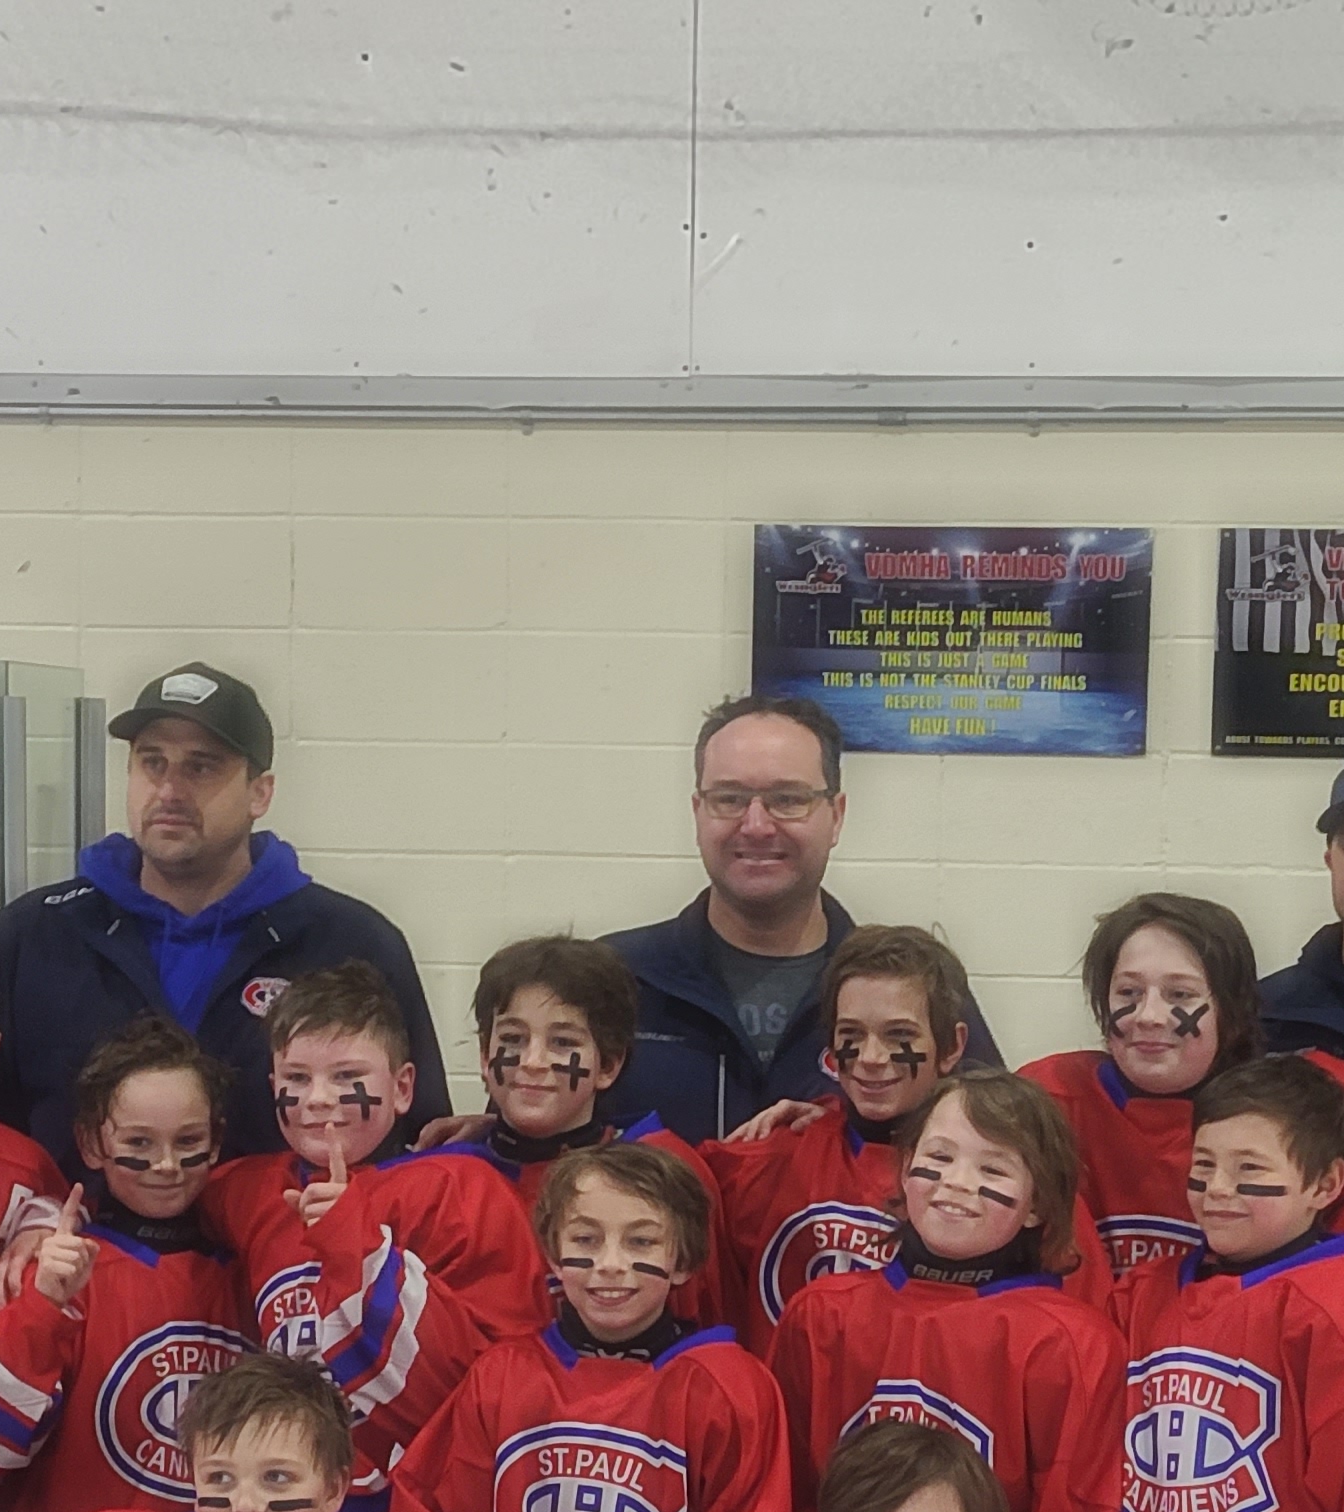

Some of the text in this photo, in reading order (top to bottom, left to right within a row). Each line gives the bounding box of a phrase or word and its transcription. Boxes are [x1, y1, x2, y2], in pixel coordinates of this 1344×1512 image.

[864, 551, 1128, 582] VDMHA REMINDS YOU
[860, 608, 1052, 627] THE REFEREES ARE HUMANS
[827, 629, 1083, 649] THESE ARE KIDS OUT THERE PLAYING
[880, 652, 911, 668] THIS
[916, 652, 931, 668] IS
[937, 652, 970, 668] JUST
[991, 653, 1029, 669] GAME
[821, 671, 1087, 691] THIS IS NOT THE STANLEY CUP FINALS
[884, 694, 1023, 711] RESPECT OUR GAME
[909, 716, 951, 736] HAVE
[813, 1222, 903, 1264] ST.PAU
